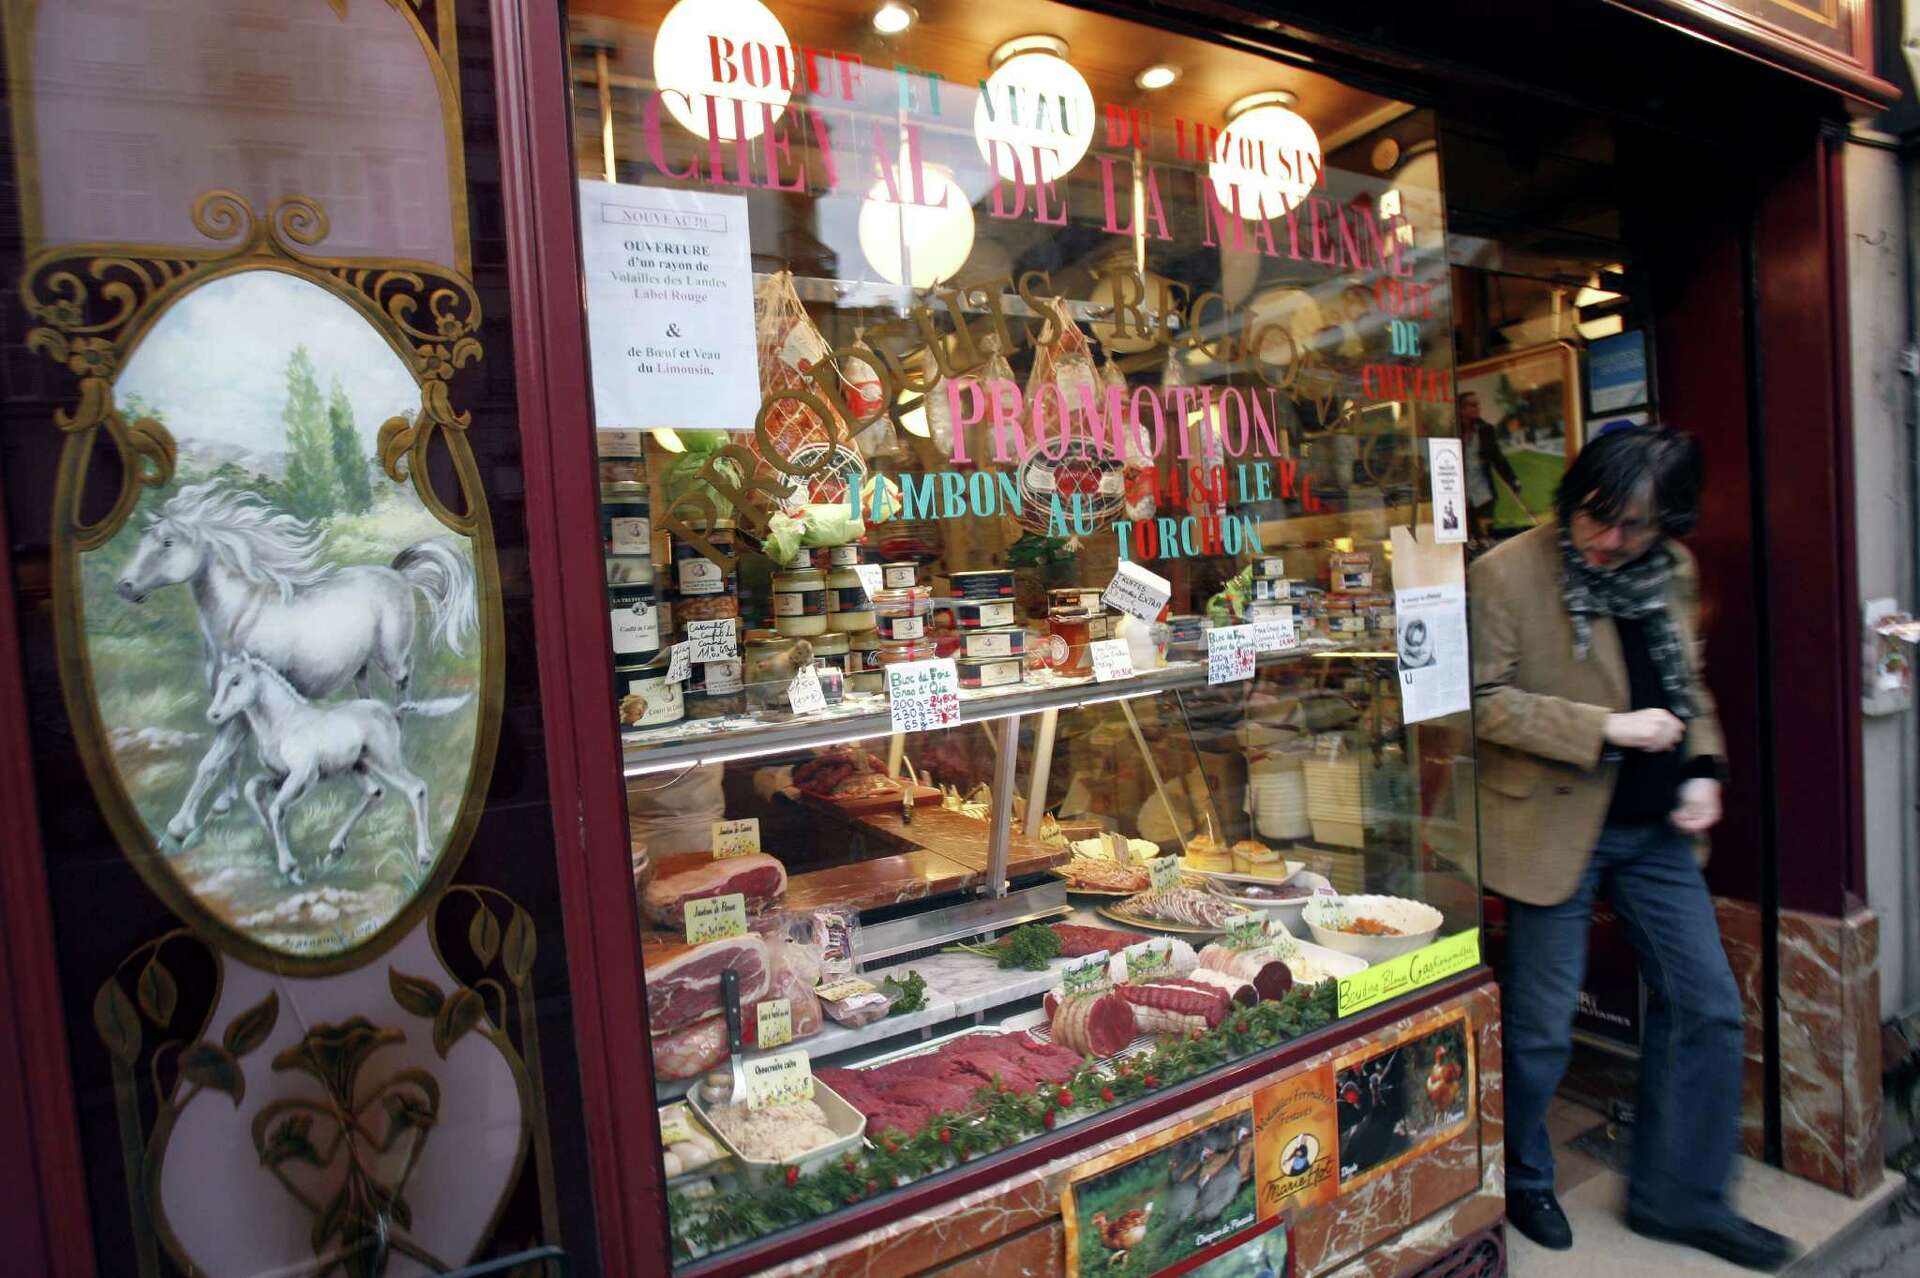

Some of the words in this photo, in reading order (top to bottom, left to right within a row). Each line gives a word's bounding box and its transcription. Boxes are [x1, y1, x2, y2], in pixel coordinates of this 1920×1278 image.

[707, 34, 864, 101] BOEUF
[895, 64, 945, 116] ET
[978, 79, 1080, 137] VEAU
[1105, 102, 1152, 151] DU
[1175, 117, 1326, 190] LIMOUSIN
[644, 88, 949, 209] CHEVAL
[985, 138, 1068, 226] DE
[1096, 154, 1174, 242] LA
[1202, 175, 1417, 278] MAYENNE
[622, 209, 690, 227] NOUVEAU
[624, 239, 711, 258] OUVERTURE
[628, 255, 656, 269] d'un
[658, 260, 693, 274] rayon
[695, 259, 709, 272] de
[611, 270, 661, 285] Volailles
[663, 272, 682, 286] des
[685, 273, 728, 288] Landes
[633, 288, 668, 301] Label
[671, 290, 708, 304] Rouge
[665, 322, 682, 338] &
[1391, 319, 1422, 357] DE
[628, 346, 642, 358] de
[679, 348, 691, 359] et
[693, 347, 721, 360] Veau
[637, 361, 654, 374] du
[656, 362, 715, 376] Limousin.
[1362, 364, 1456, 404] CHEVAL
[946, 378, 1282, 464] PROMOTION
[848, 470, 1024, 522] JAMBON
[1237, 461, 1273, 504] LE
[1279, 457, 1321, 513] KG
[1047, 492, 1095, 539] AU
[1112, 514, 1264, 562] TORCHON
